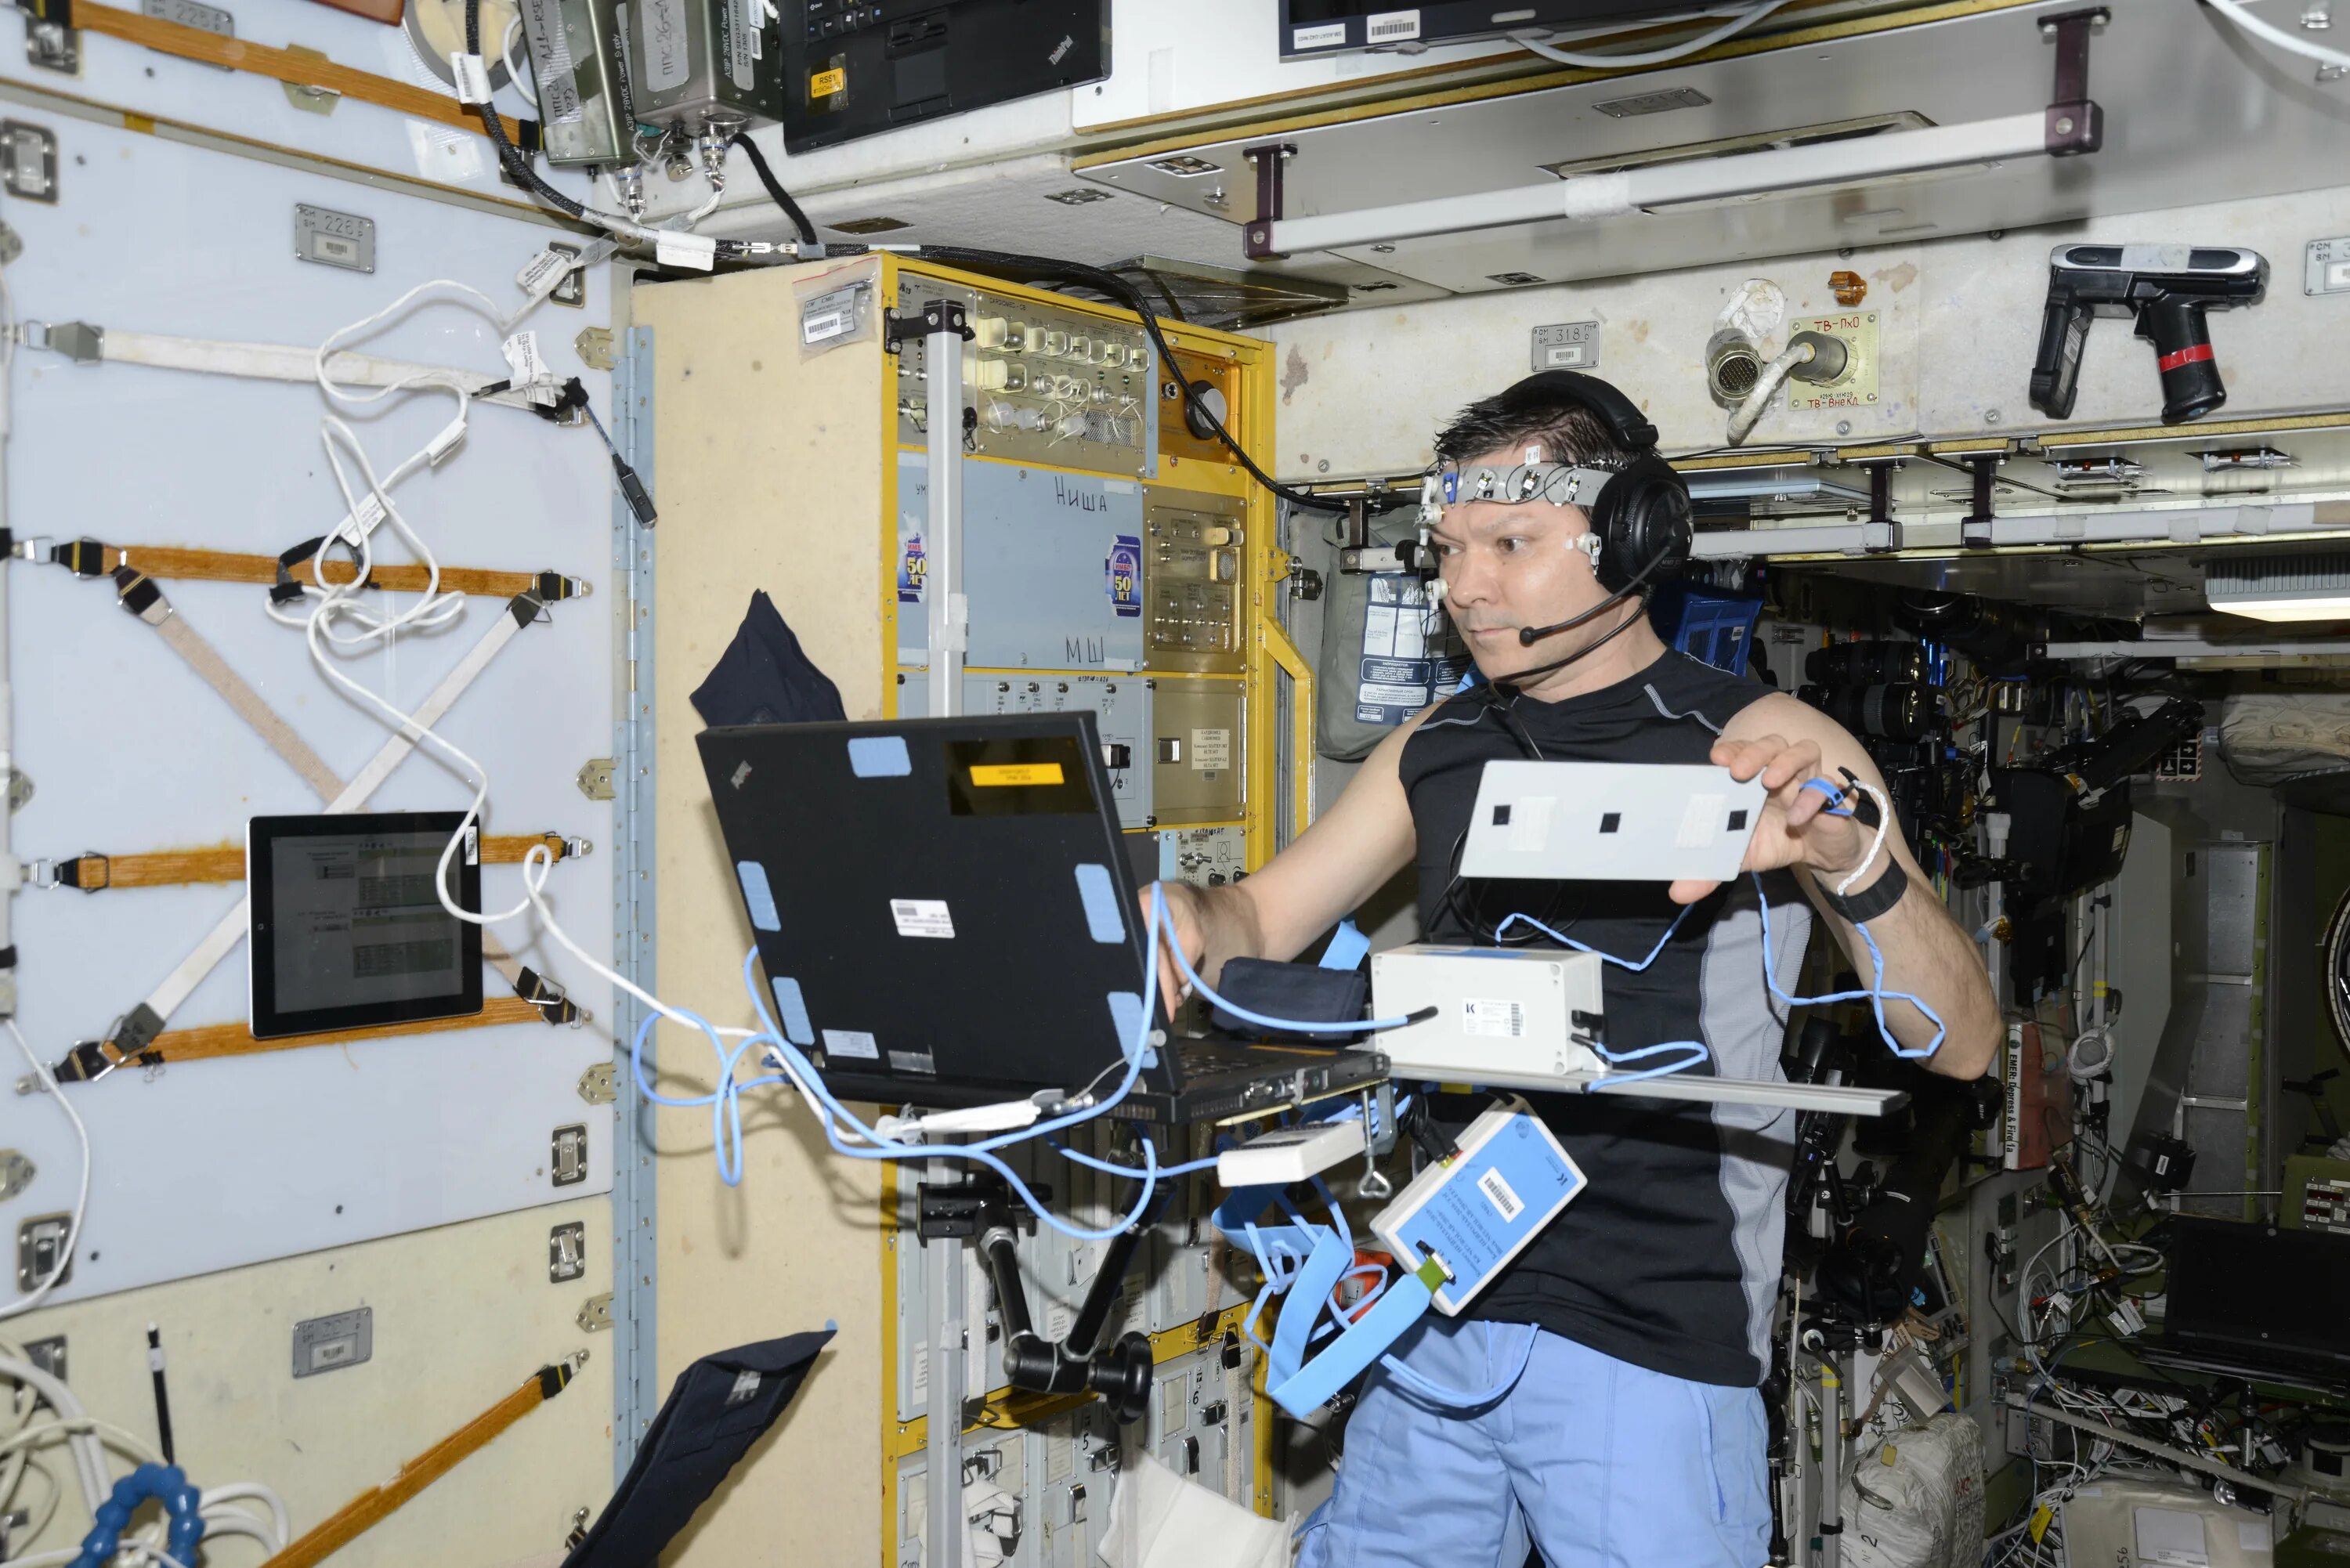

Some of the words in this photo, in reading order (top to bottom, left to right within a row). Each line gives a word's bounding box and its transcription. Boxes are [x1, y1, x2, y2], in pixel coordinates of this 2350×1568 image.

[1048, 35, 1073, 66] ThinkPad
[819, 74, 837, 85] RSS1
[325, 215, 354, 235] 226
[1556, 327, 1580, 341] 318
[916, 483, 928, 496] УМ
[907, 557, 927, 575] 50
[1115, 575, 1132, 591] 50
[1115, 591, 1130, 602] ЛЕТ
[1065, 636, 1104, 663] МШ
[2008, 1053, 2018, 1079] EMER:
[2006, 1081, 2017, 1115] Depress
[2007, 1125, 2016, 1142] Fire
[1192, 1390, 1199, 1404] 6
[1083, 1433, 1089, 1451] 5
[1860, 1534, 1878, 1548] 2
